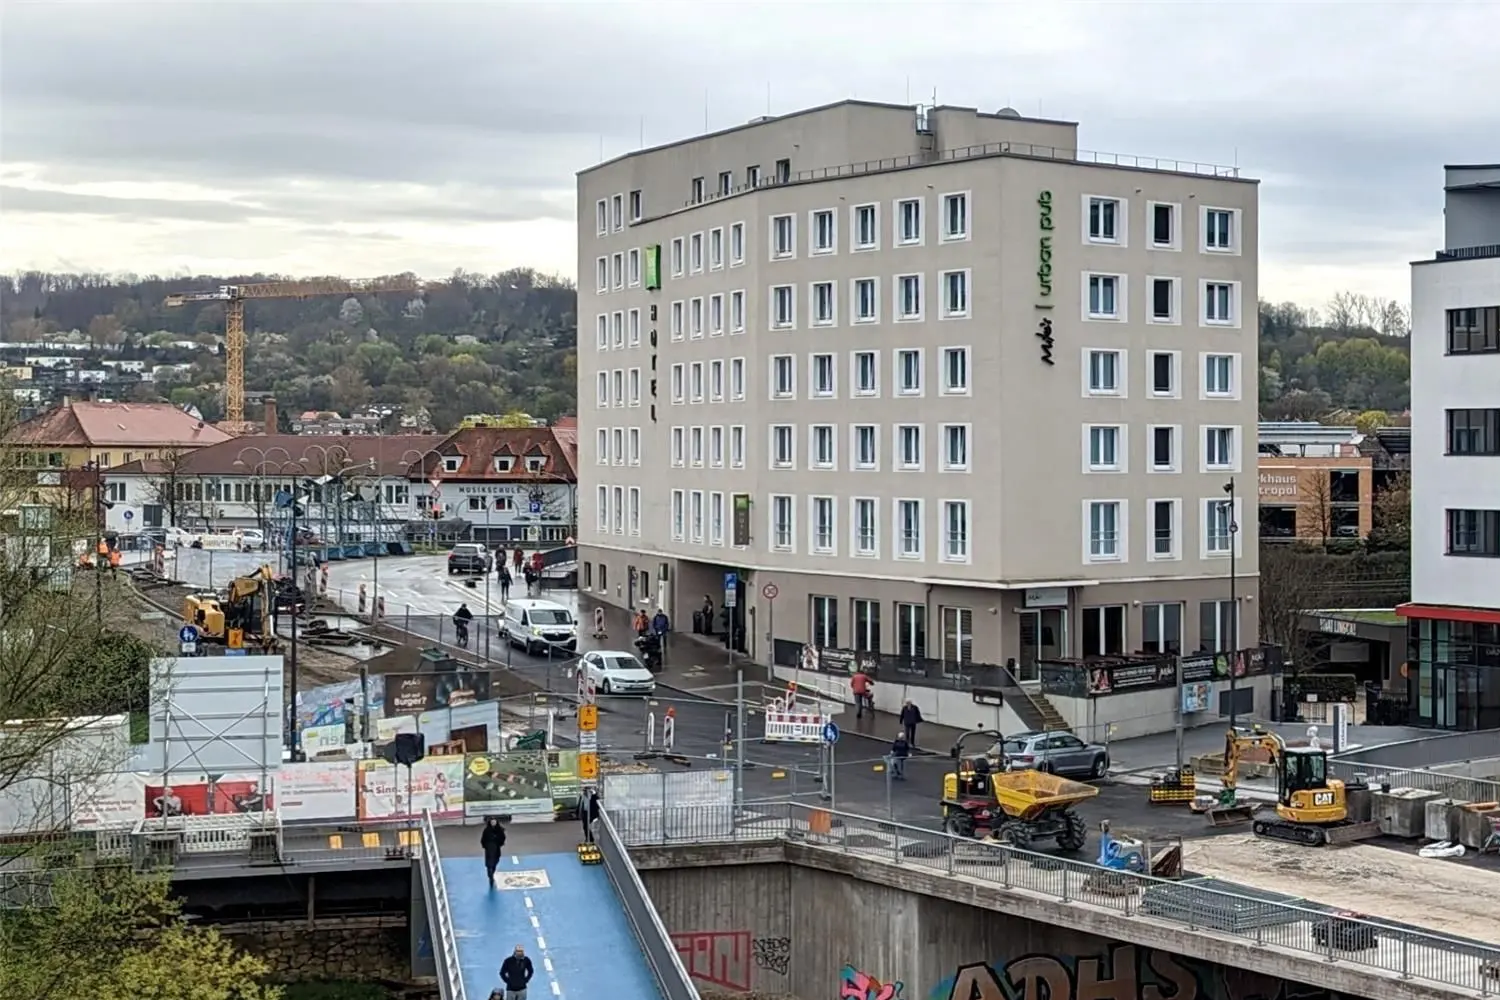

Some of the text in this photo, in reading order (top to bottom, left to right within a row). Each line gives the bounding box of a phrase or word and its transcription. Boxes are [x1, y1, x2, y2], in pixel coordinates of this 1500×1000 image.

[1037, 190, 1055, 232] pub
[1036, 236, 1053, 297] urban
[1258, 473, 1297, 483] khaus
[459, 486, 521, 494] MUSIKSCHULE
[531, 503, 538, 512] P
[394, 695, 427, 707] Burger?
[1313, 792, 1334, 806] CAT
